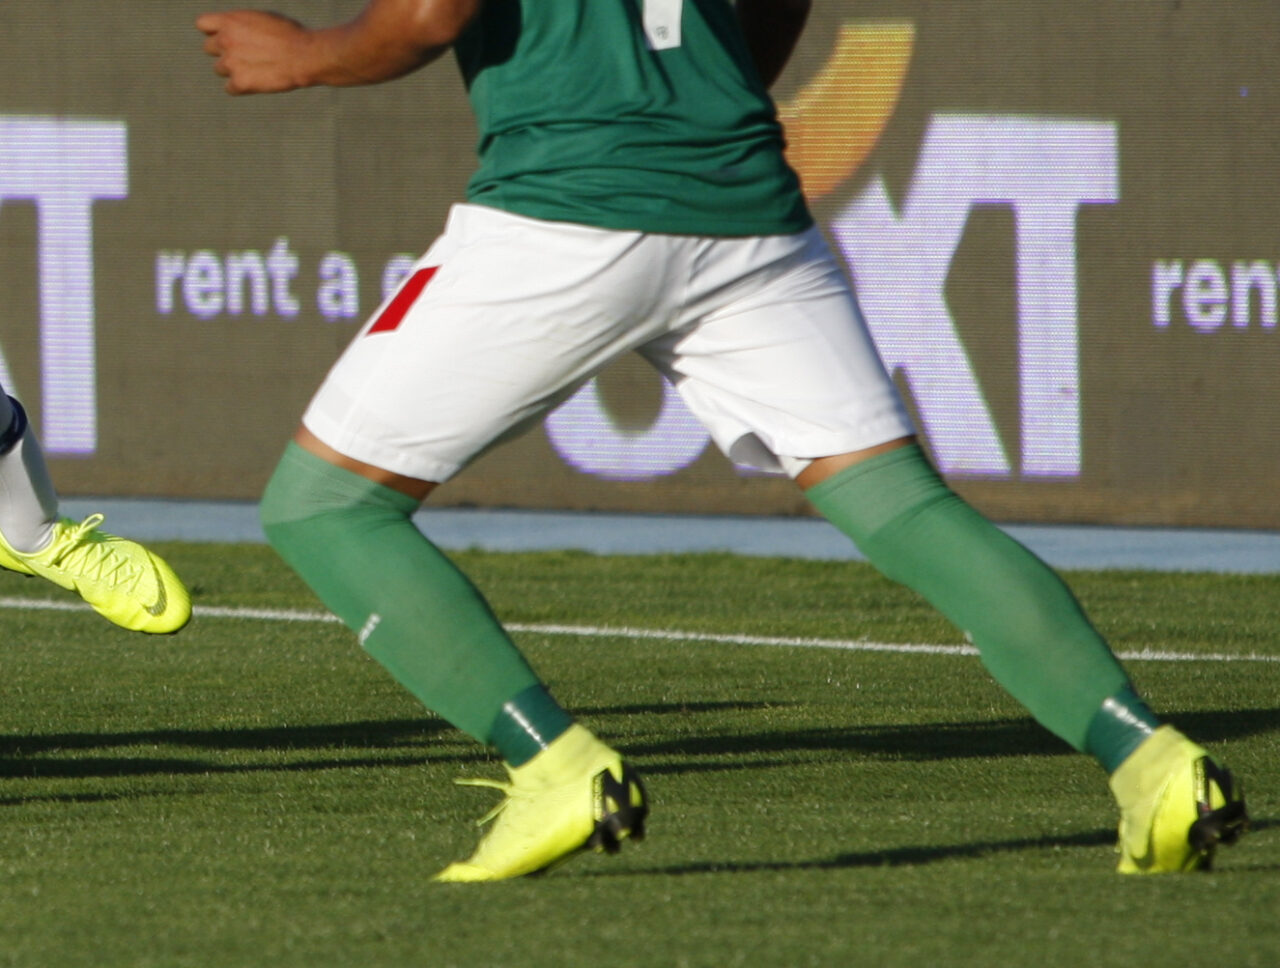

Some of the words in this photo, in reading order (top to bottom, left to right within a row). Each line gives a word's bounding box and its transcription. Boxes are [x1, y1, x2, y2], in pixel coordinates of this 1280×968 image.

[155, 236, 300, 319] rent
[317, 250, 360, 320] a
[1151, 259, 1280, 332] ren
